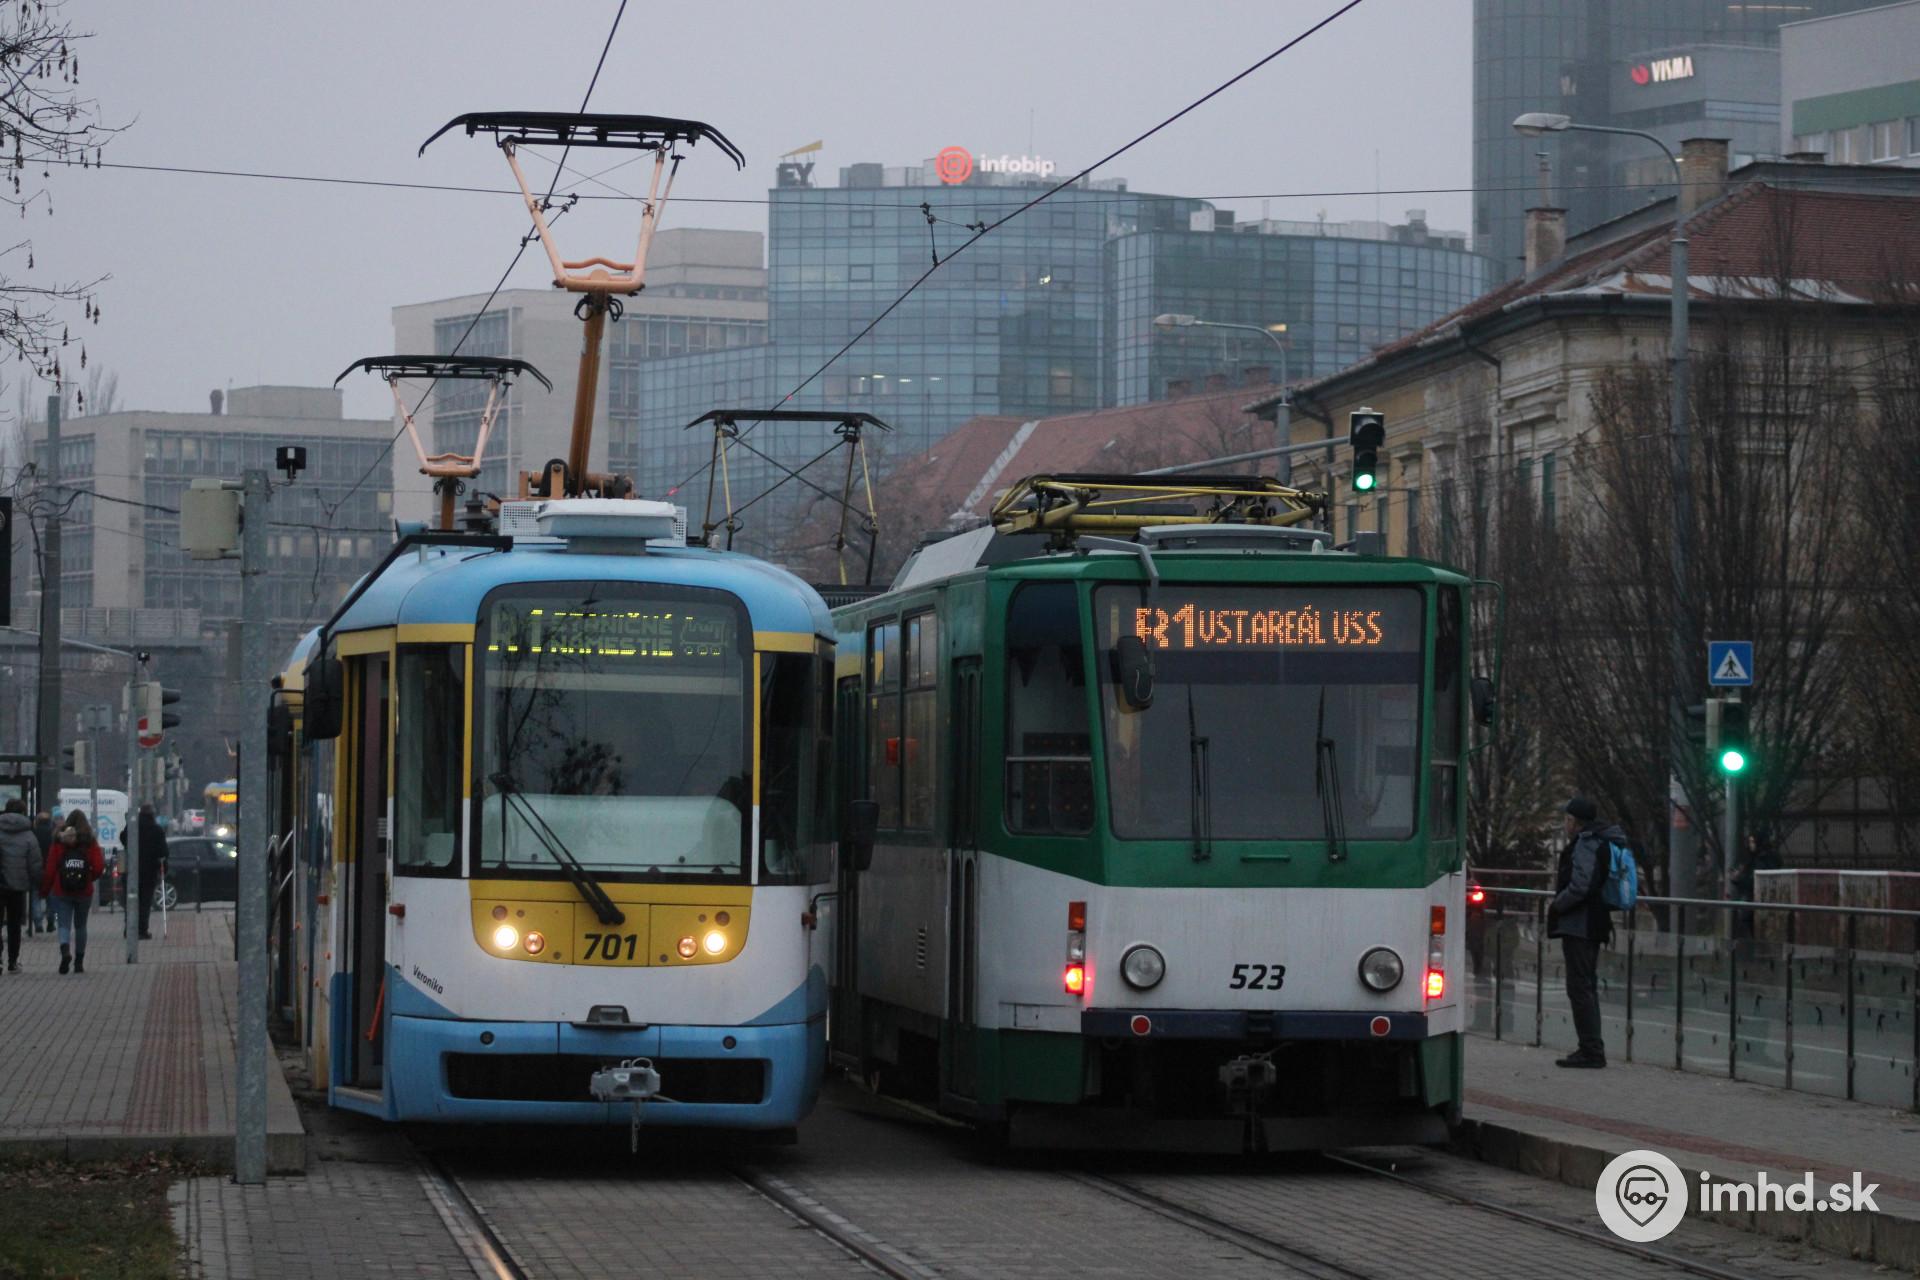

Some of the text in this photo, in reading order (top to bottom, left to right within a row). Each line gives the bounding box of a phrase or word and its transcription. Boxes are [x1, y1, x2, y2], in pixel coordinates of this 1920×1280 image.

[1651, 56, 1694, 82] VISMA
[777, 162, 815, 188] EY
[980, 154, 1055, 177] infobip
[1136, 604, 1194, 648] R1
[1333, 611, 1383, 644] USS
[65, 859, 84, 869] VANS
[583, 933, 639, 960] 701
[413, 964, 444, 994] Veronika
[1229, 964, 1286, 990] 523
